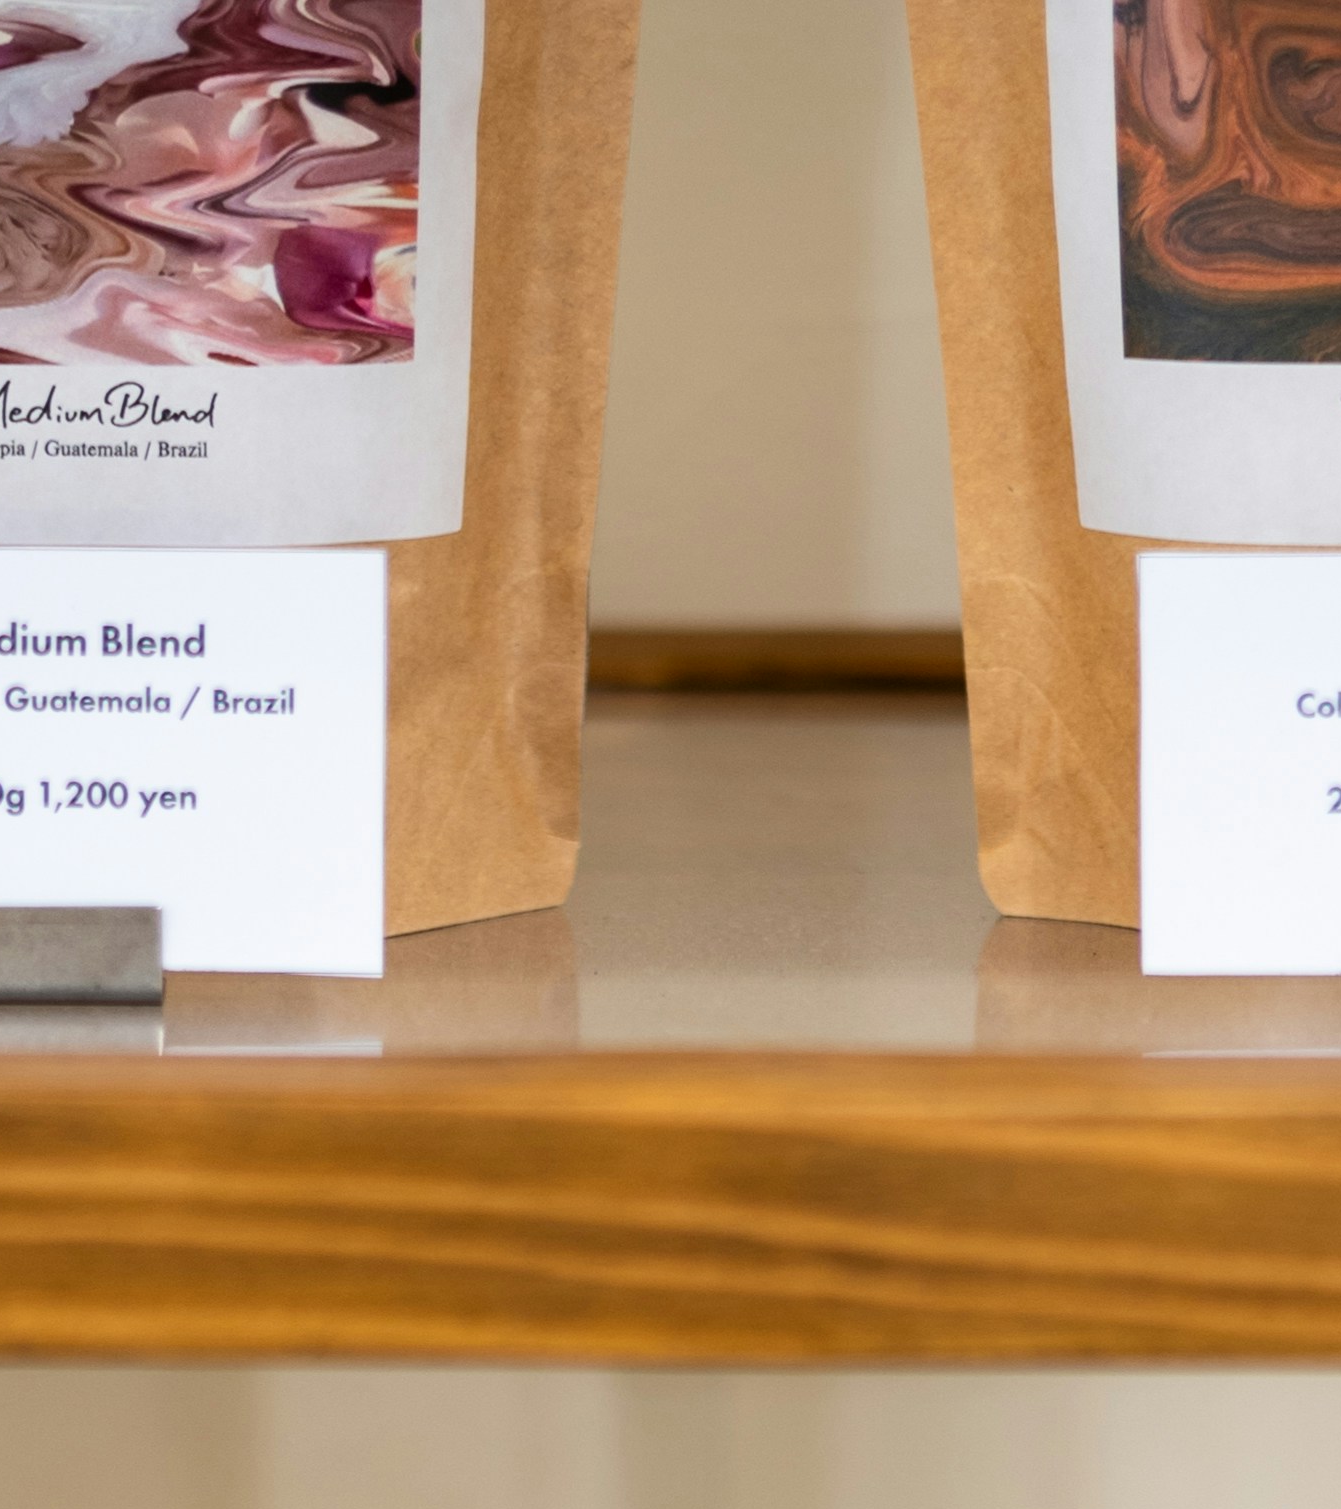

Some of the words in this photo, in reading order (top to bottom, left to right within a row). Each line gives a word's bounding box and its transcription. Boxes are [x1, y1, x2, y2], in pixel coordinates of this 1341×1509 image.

[103, 381, 218, 428] Blend
[43, 439, 139, 458] Guatemala
[158, 440, 208, 458] Brazil
[101, 623, 206, 657] Blend
[4, 686, 171, 713] Guatemala
[213, 687, 295, 714] Brazil
[40, 780, 129, 815] 1,200
[138, 790, 197, 817] yen
